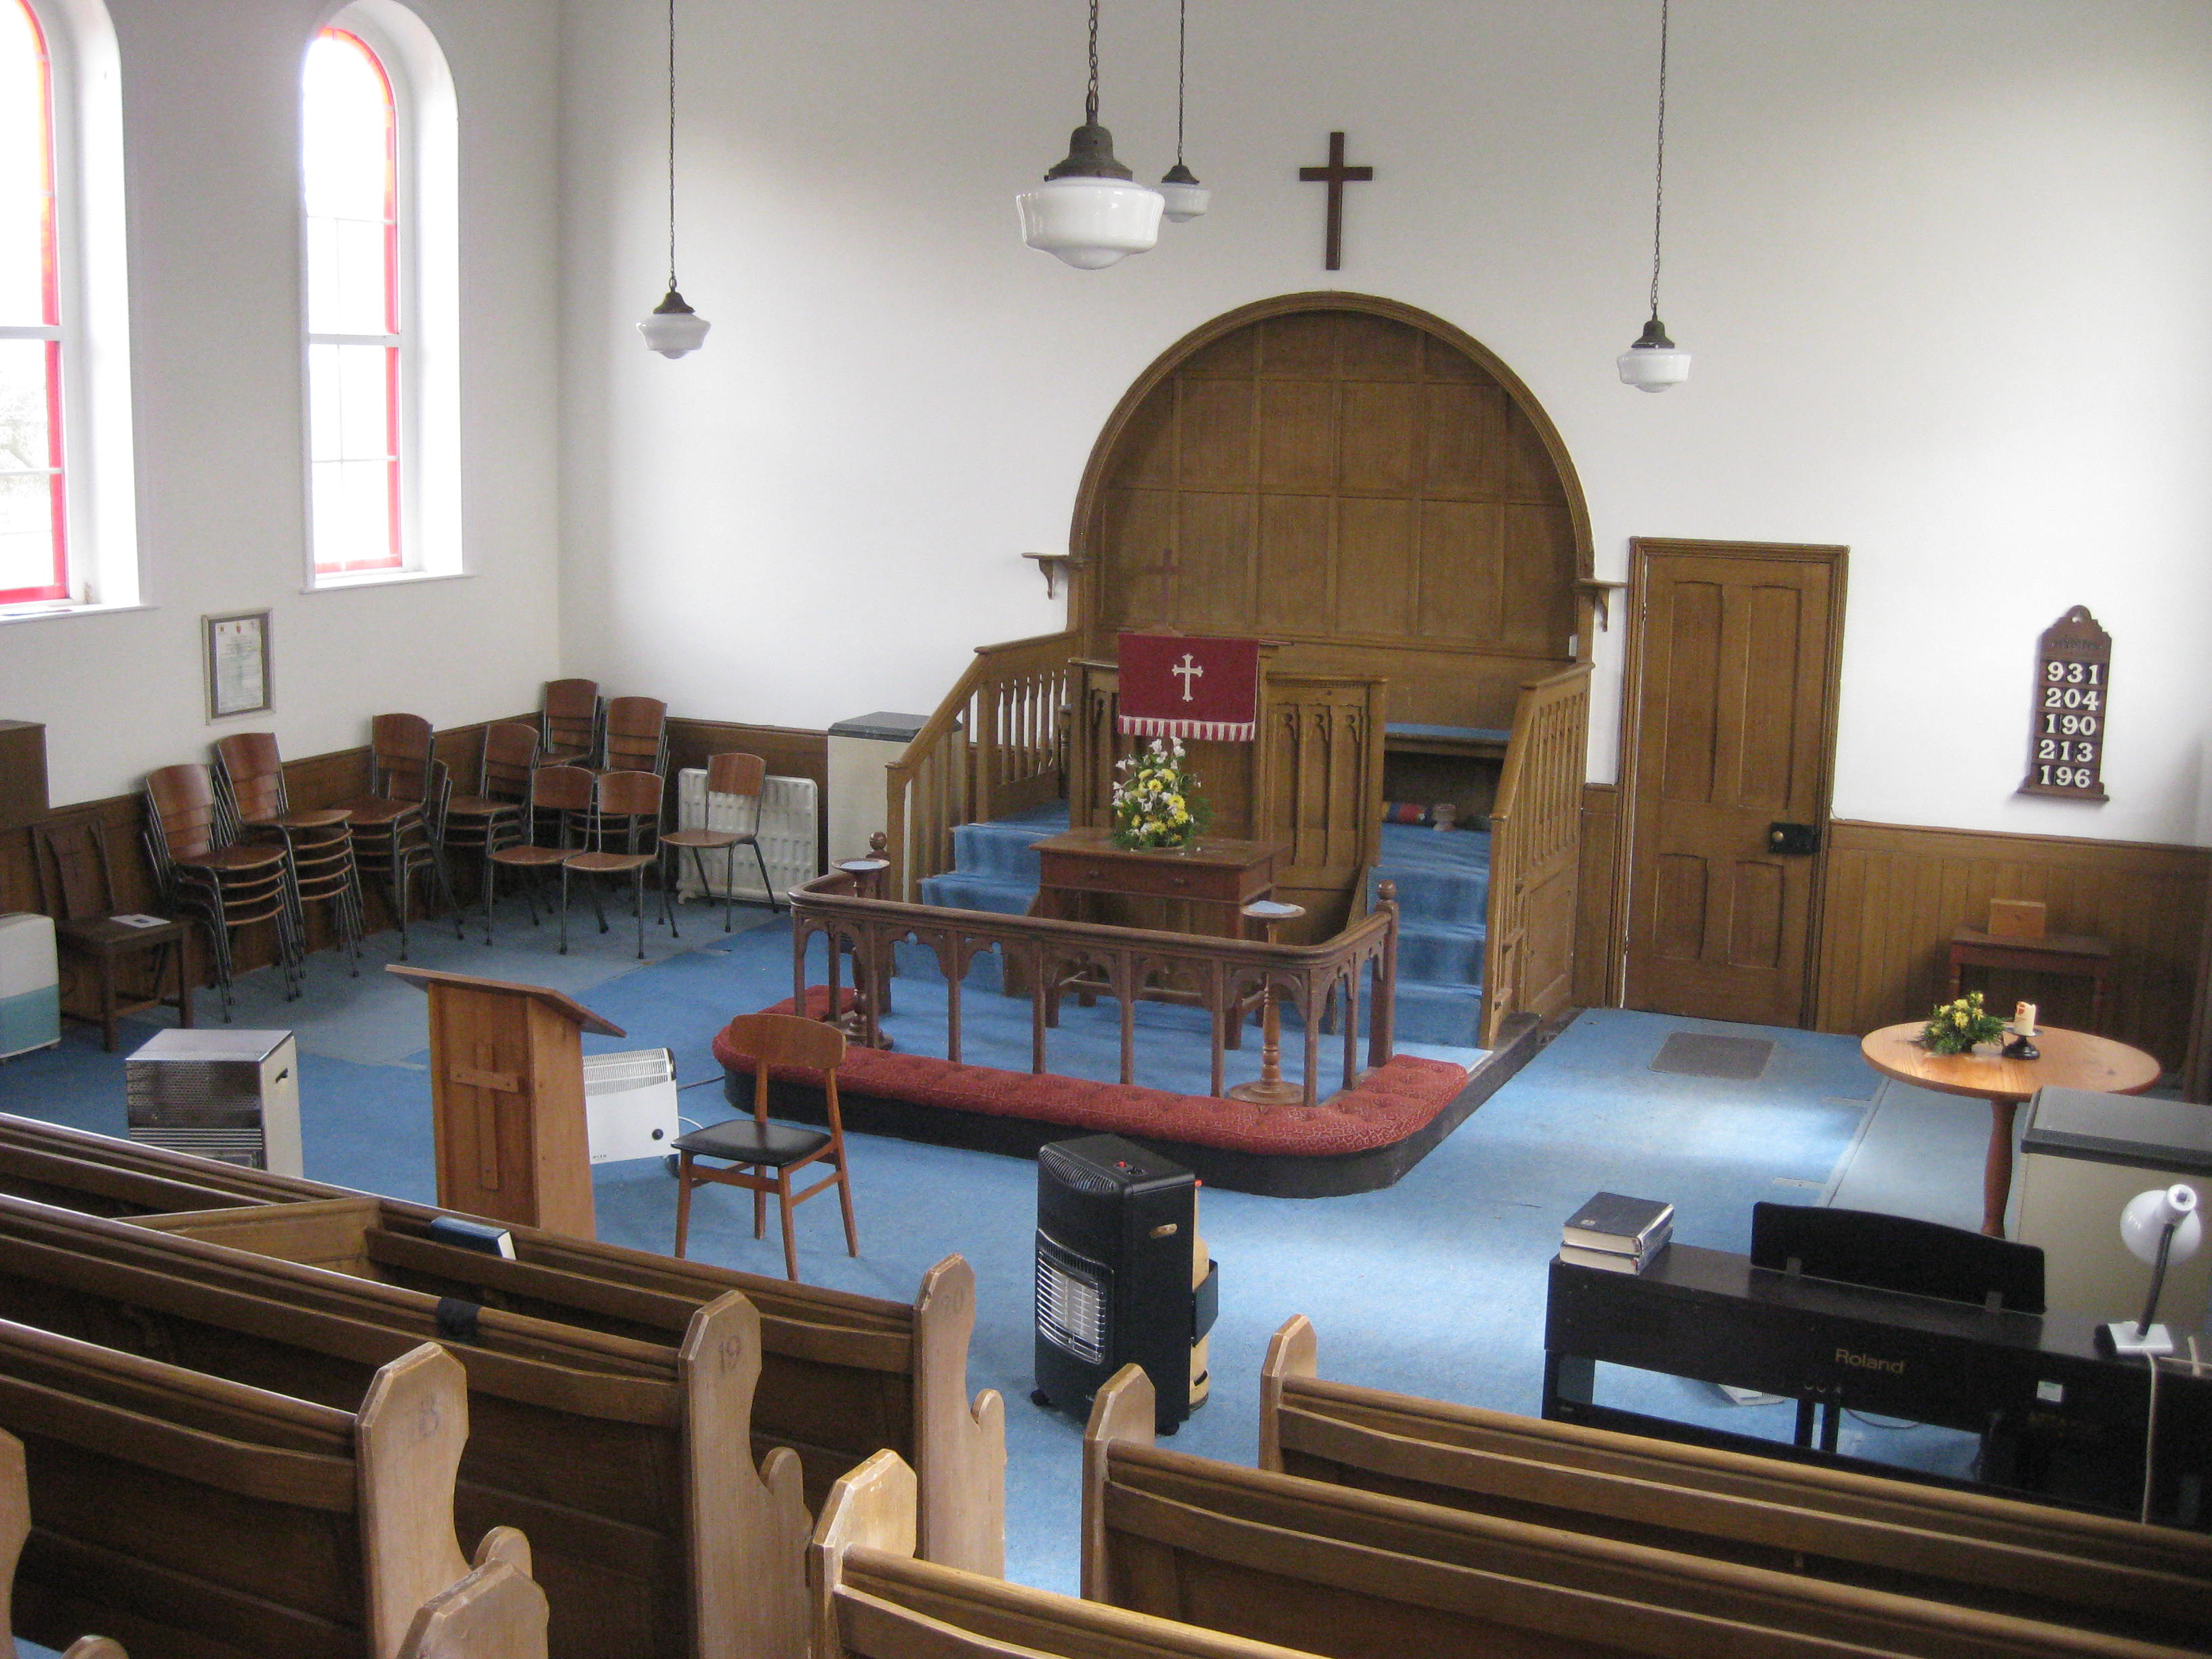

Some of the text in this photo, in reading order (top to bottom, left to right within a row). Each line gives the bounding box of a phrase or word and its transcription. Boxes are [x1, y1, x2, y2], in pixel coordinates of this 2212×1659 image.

[2047, 661, 2098, 684] 931
[2045, 687, 2099, 711] 204
[2046, 714, 2096, 736] 190
[2039, 739, 2093, 762] 213
[2041, 765, 2091, 788] 196
[1835, 1349, 1904, 1374] Roland
